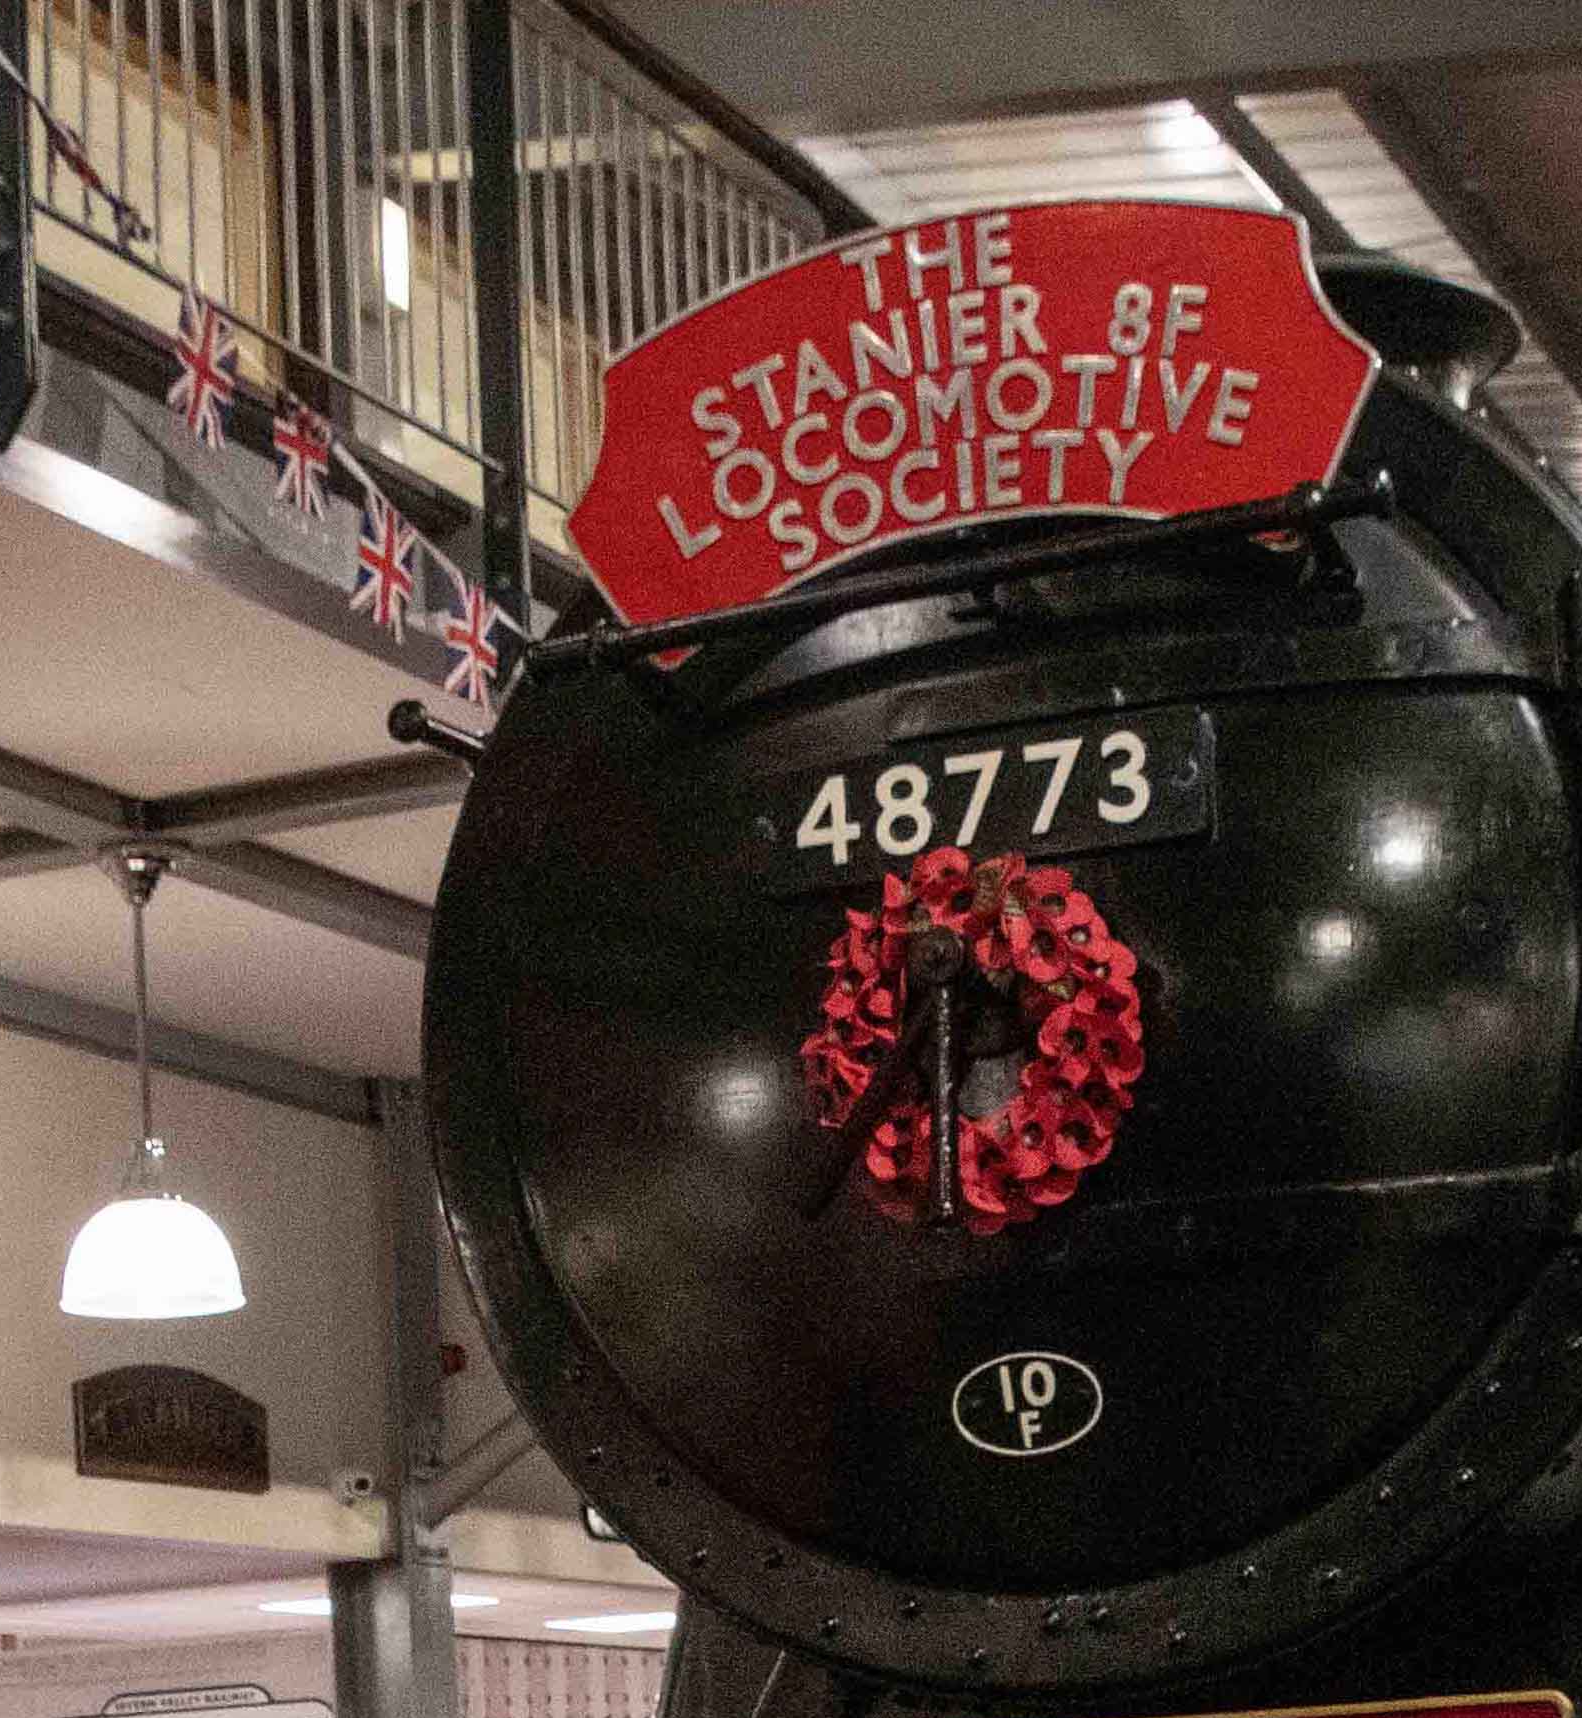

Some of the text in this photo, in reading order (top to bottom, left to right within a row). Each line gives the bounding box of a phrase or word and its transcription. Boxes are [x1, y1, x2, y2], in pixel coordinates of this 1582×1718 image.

[842, 213, 1015, 314] THE
[691, 281, 1210, 463] STANIER 8F
[658, 352, 1260, 560] LOCOMOTIVE
[769, 429, 1156, 573] SOCIETY
[795, 730, 1153, 868] 48773
[999, 1360, 1056, 1413] 10
[1020, 1409, 1042, 1449] F
